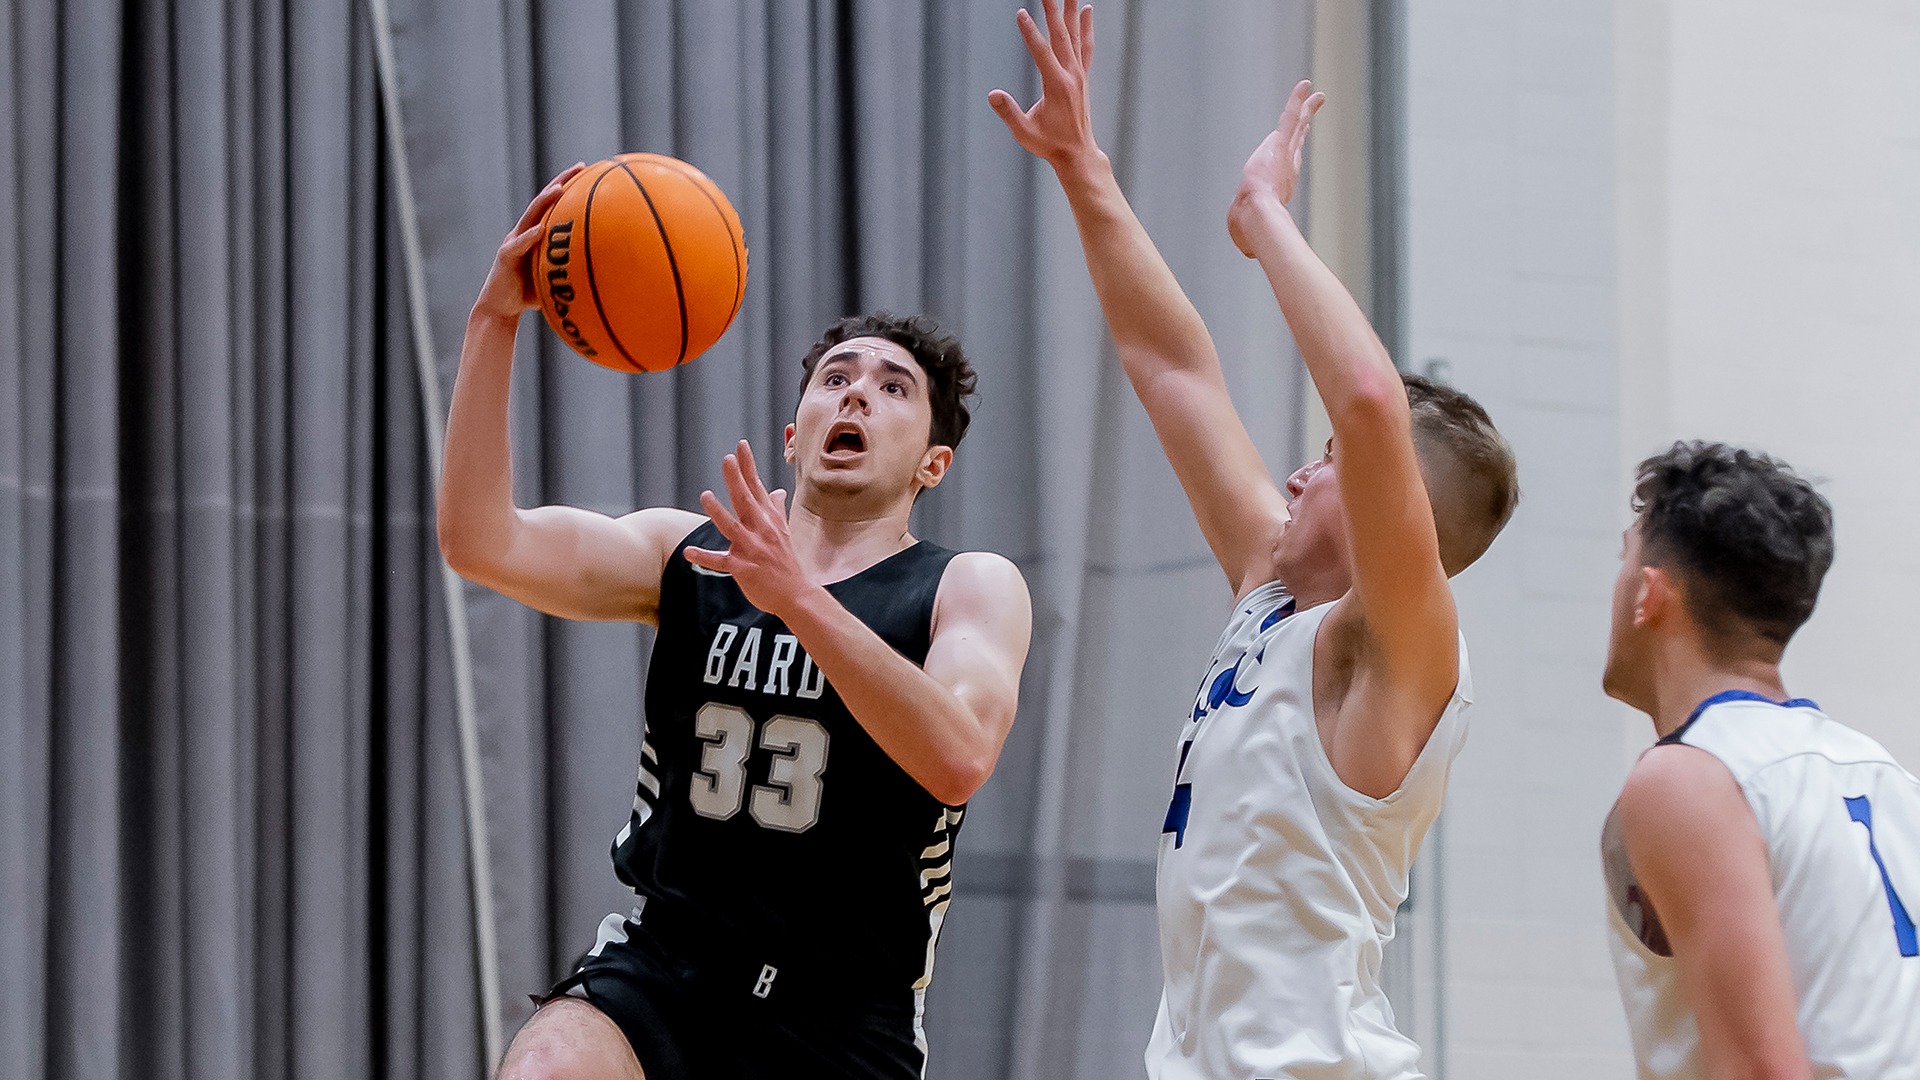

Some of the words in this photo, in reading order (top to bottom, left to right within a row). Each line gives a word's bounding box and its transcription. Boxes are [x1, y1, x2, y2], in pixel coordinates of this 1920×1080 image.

[546, 218, 598, 357] Wilson
[689, 701, 830, 834] 33
[1842, 794, 1920, 958] 1
[752, 963, 778, 999] B
